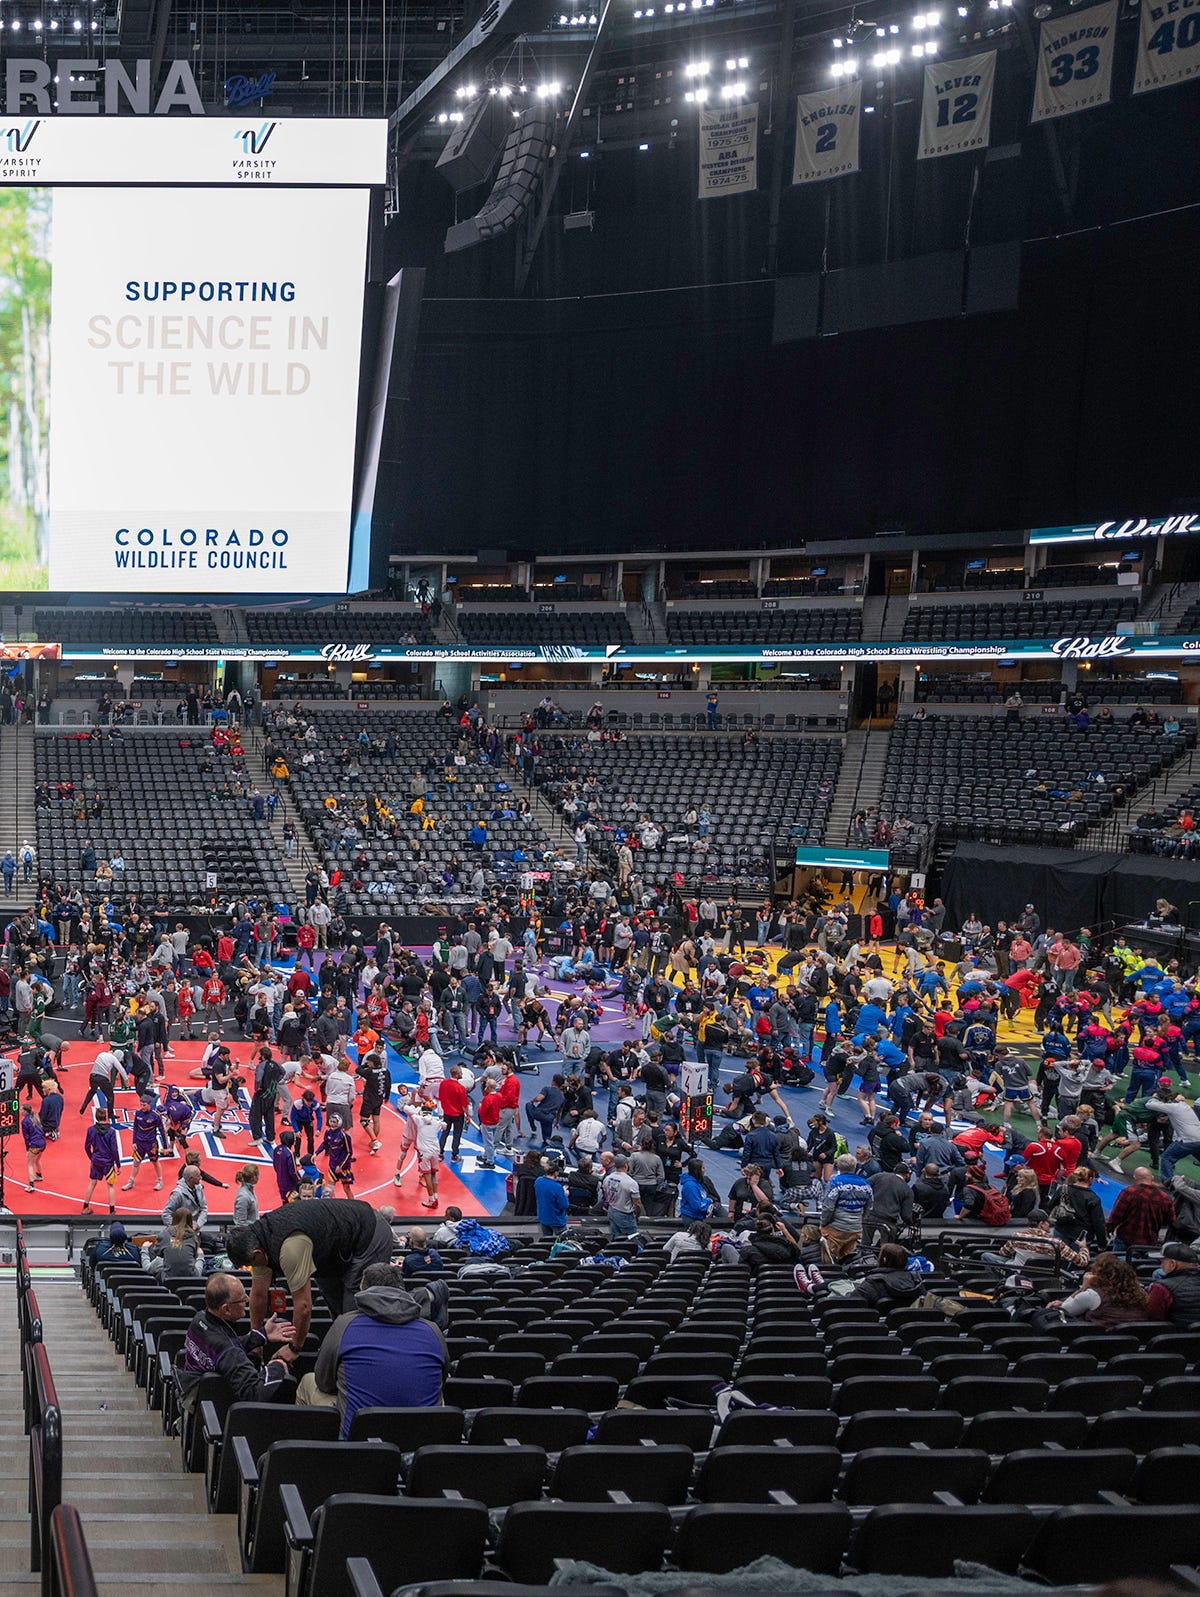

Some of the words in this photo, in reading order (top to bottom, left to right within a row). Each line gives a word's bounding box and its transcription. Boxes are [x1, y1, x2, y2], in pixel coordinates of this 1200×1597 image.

[1043, 26, 1110, 54] THOMPSON
[1049, 45, 1100, 88] 33
[225, 71, 277, 107] Ball
[934, 75, 982, 95] LEVER
[801, 104, 856, 126] ENGLISH
[936, 93, 979, 127] 12
[710, 126, 748, 138] CHAMPIONS
[815, 122, 838, 154] 2
[923, 136, 984, 155] 1984-1990
[233, 160, 277, 168] VARSITY
[718, 150, 738, 161] ABA
[3, 169, 37, 177] SPIRIT
[238, 171, 272, 179] SPIRIT
[708, 174, 748, 187] 1974-75
[709, 165, 747, 177] CHAMPIONS
[125, 281, 295, 302] SUPPORTING
[87, 315, 271, 350] SCIENCE
[288, 316, 329, 350] IN
[109, 362, 191, 395] THE
[208, 363, 311, 396] WILD
[115, 528, 289, 547] COLORADO
[115, 550, 198, 569] WILDLIFE
[208, 550, 288, 569] COUNCIL
[103, 648, 129, 656] Welcome
[136, 648, 146, 656] the
[146, 648, 172, 656] Colorado
[172, 648, 186, 657] High
[186, 648, 205, 656] School
[221, 648, 248, 657] Wrestling
[248, 648, 290, 657] Championships
[320, 643, 376, 662] Ball
[405, 649, 434, 657] Colorado
[434, 649, 450, 659] High
[450, 649, 472, 658] School
[472, 649, 500, 658] Activities
[500, 649, 537, 658] Association
[803, 648, 815, 656] the
[816, 648, 848, 656] Colorado
[848, 647, 866, 657] High
[867, 647, 891, 655] School
[891, 647, 911, 655] State
[911, 647, 948, 656] Wrestling
[948, 645, 1006, 656] Championships
[1051, 636, 1135, 658] Ball
[1182, 640, 1200, 650] Col
[0, 1071, 7, 1090] 6
[684, 1075, 690, 1093] 4
[697, 1074, 703, 1093] 4
[0, 1102, 7, 1113] 0
[12, 1100, 19, 1111] 0
[706, 1095, 712, 1106] 0
[706, 1105, 712, 1116] 0
